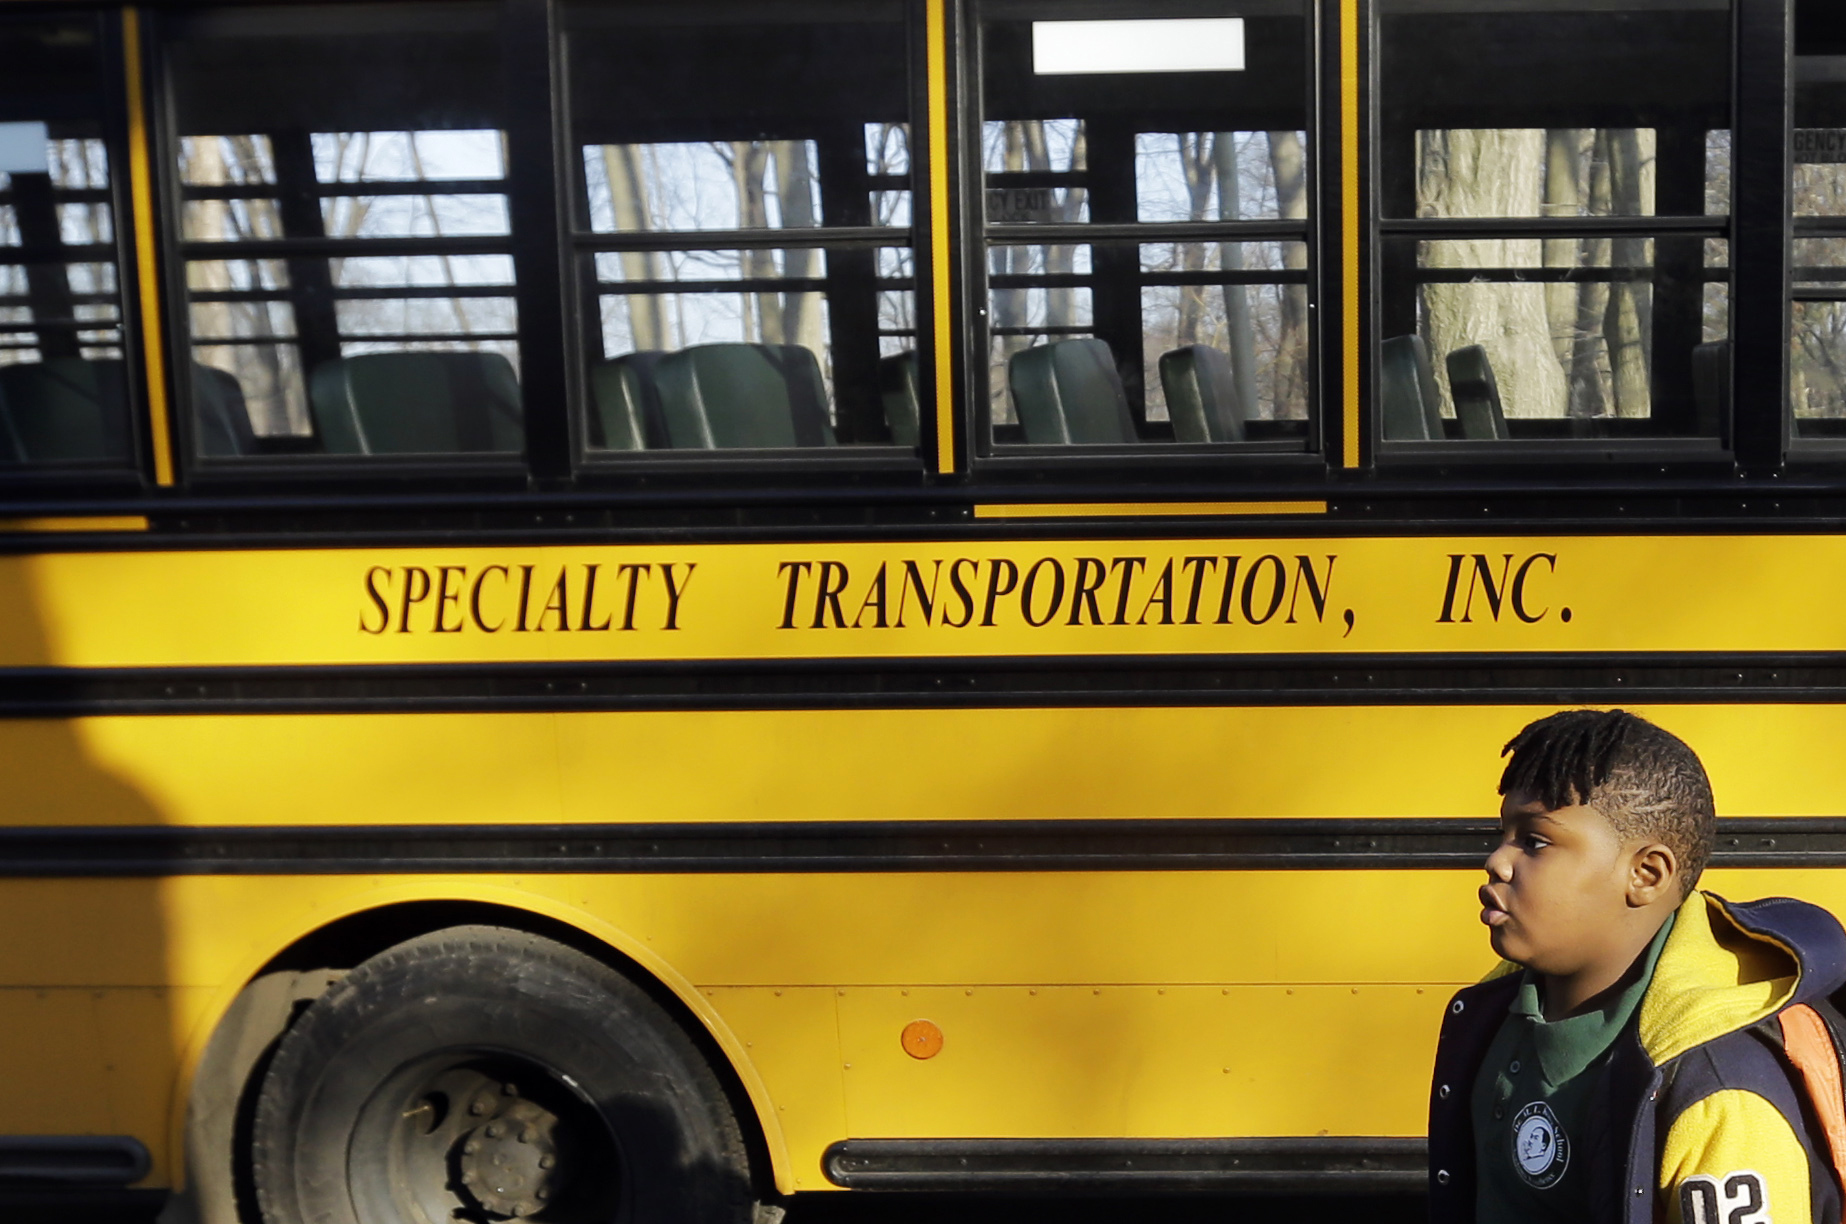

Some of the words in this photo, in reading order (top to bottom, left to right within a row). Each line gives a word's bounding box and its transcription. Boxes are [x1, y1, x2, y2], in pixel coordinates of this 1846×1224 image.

[1794, 131, 1846, 151] GENCY
[360, 563, 697, 634] SPECIALTY
[777, 555, 1355, 638] TRANSPORTATION,
[1436, 554, 1573, 624] INC.
